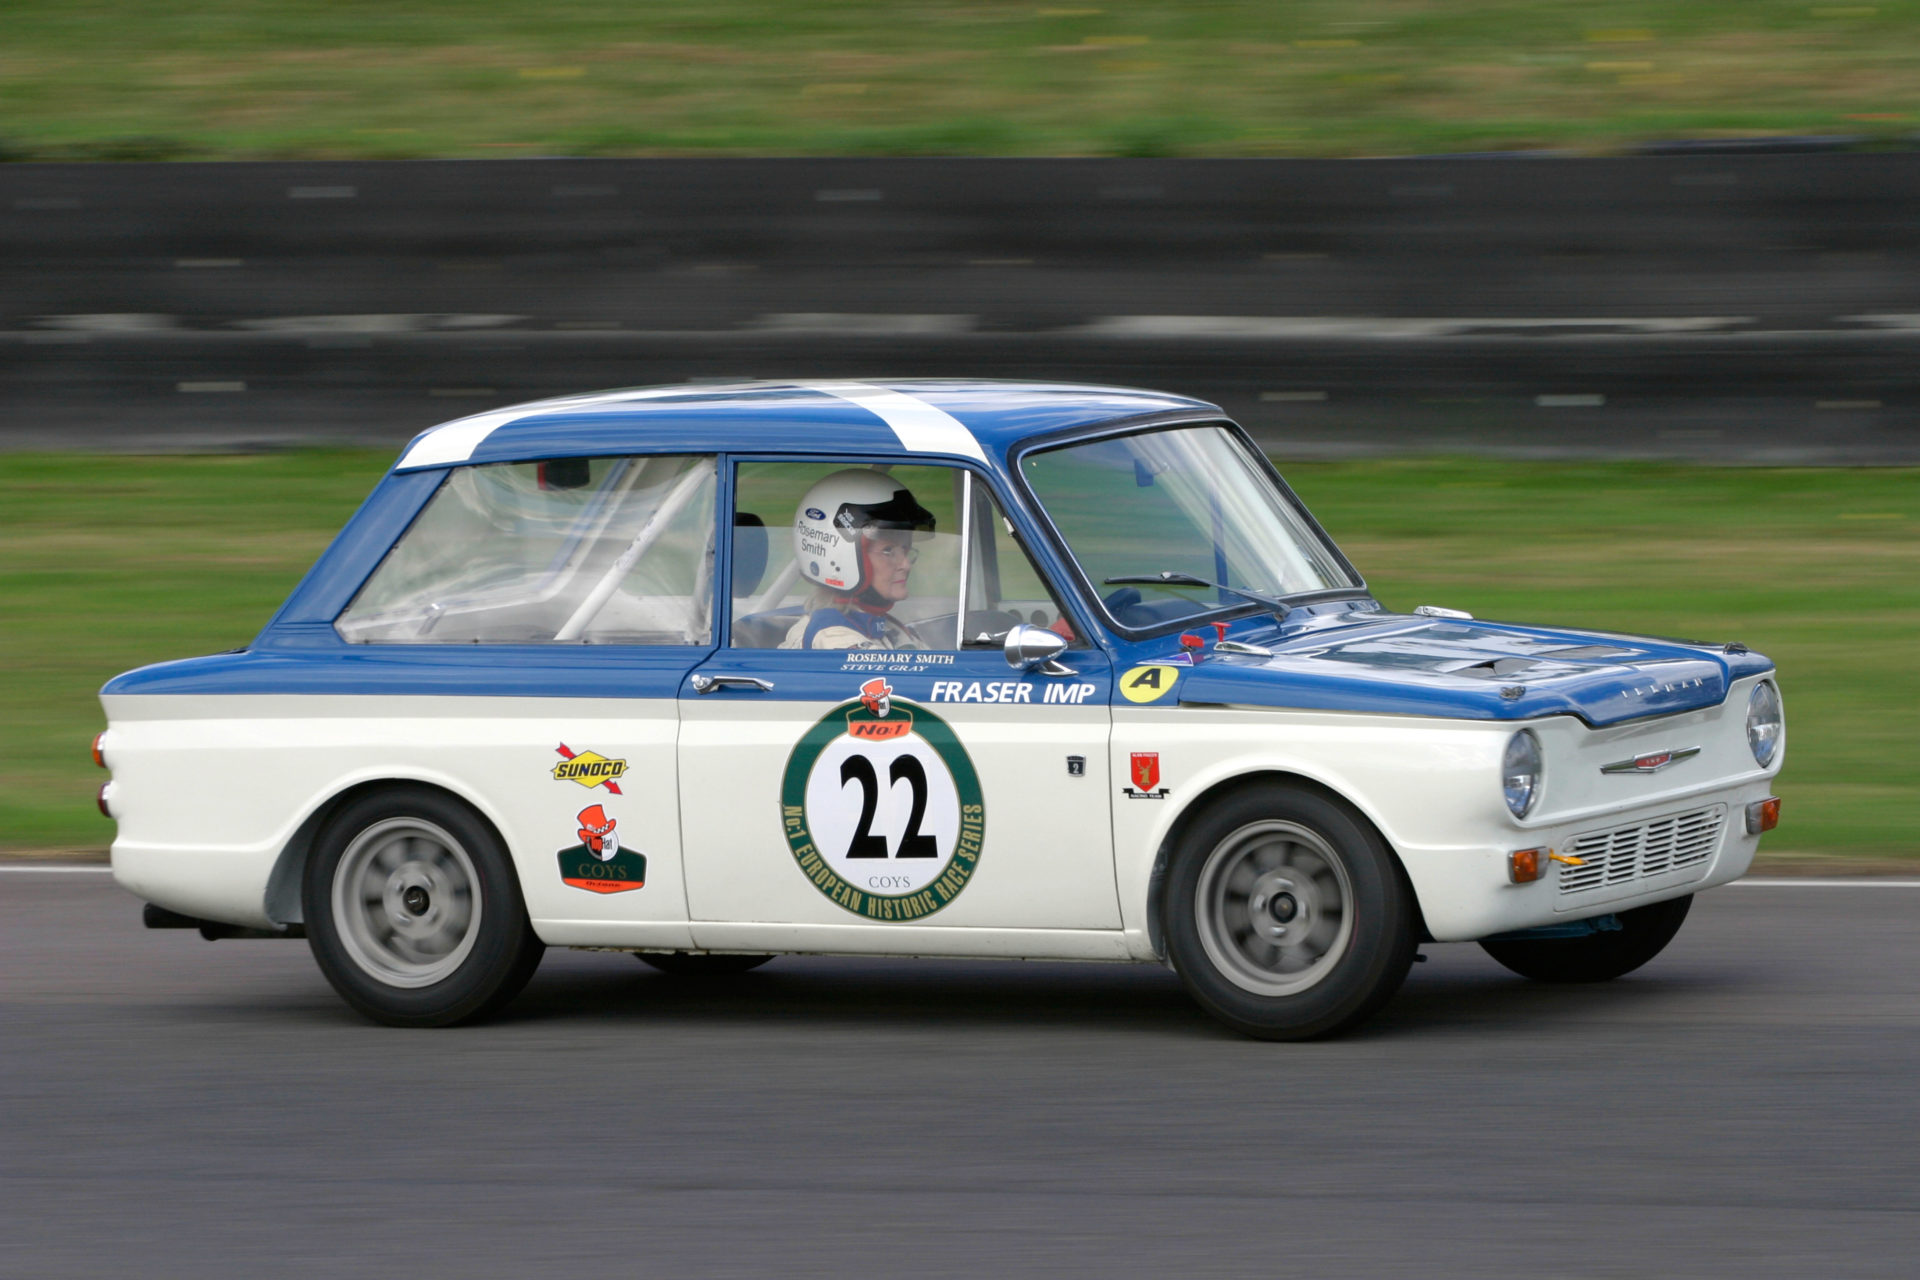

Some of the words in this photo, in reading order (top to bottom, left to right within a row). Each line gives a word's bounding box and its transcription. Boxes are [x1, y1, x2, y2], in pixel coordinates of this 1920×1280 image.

[798, 520, 839, 547] Rosemary
[801, 538, 826, 557] Smith
[840, 664, 887, 672] STEVE
[888, 665, 929, 673] GRAY
[847, 653, 913, 664] ROSEMARY
[915, 654, 955, 665] SMITH
[1129, 668, 1161, 689] A
[930, 681, 1033, 703] FRASER
[1043, 683, 1096, 704] IMP
[557, 761, 623, 777] SUNOCO
[840, 754, 938, 858] 22
[578, 863, 627, 879] COYS
[794, 843, 862, 911] EUROPEAN
[867, 894, 938, 919] HISTORIC
[934, 862, 970, 901] RACE
[958, 804, 982, 861] SERIES
[868, 876, 911, 888] COYS
